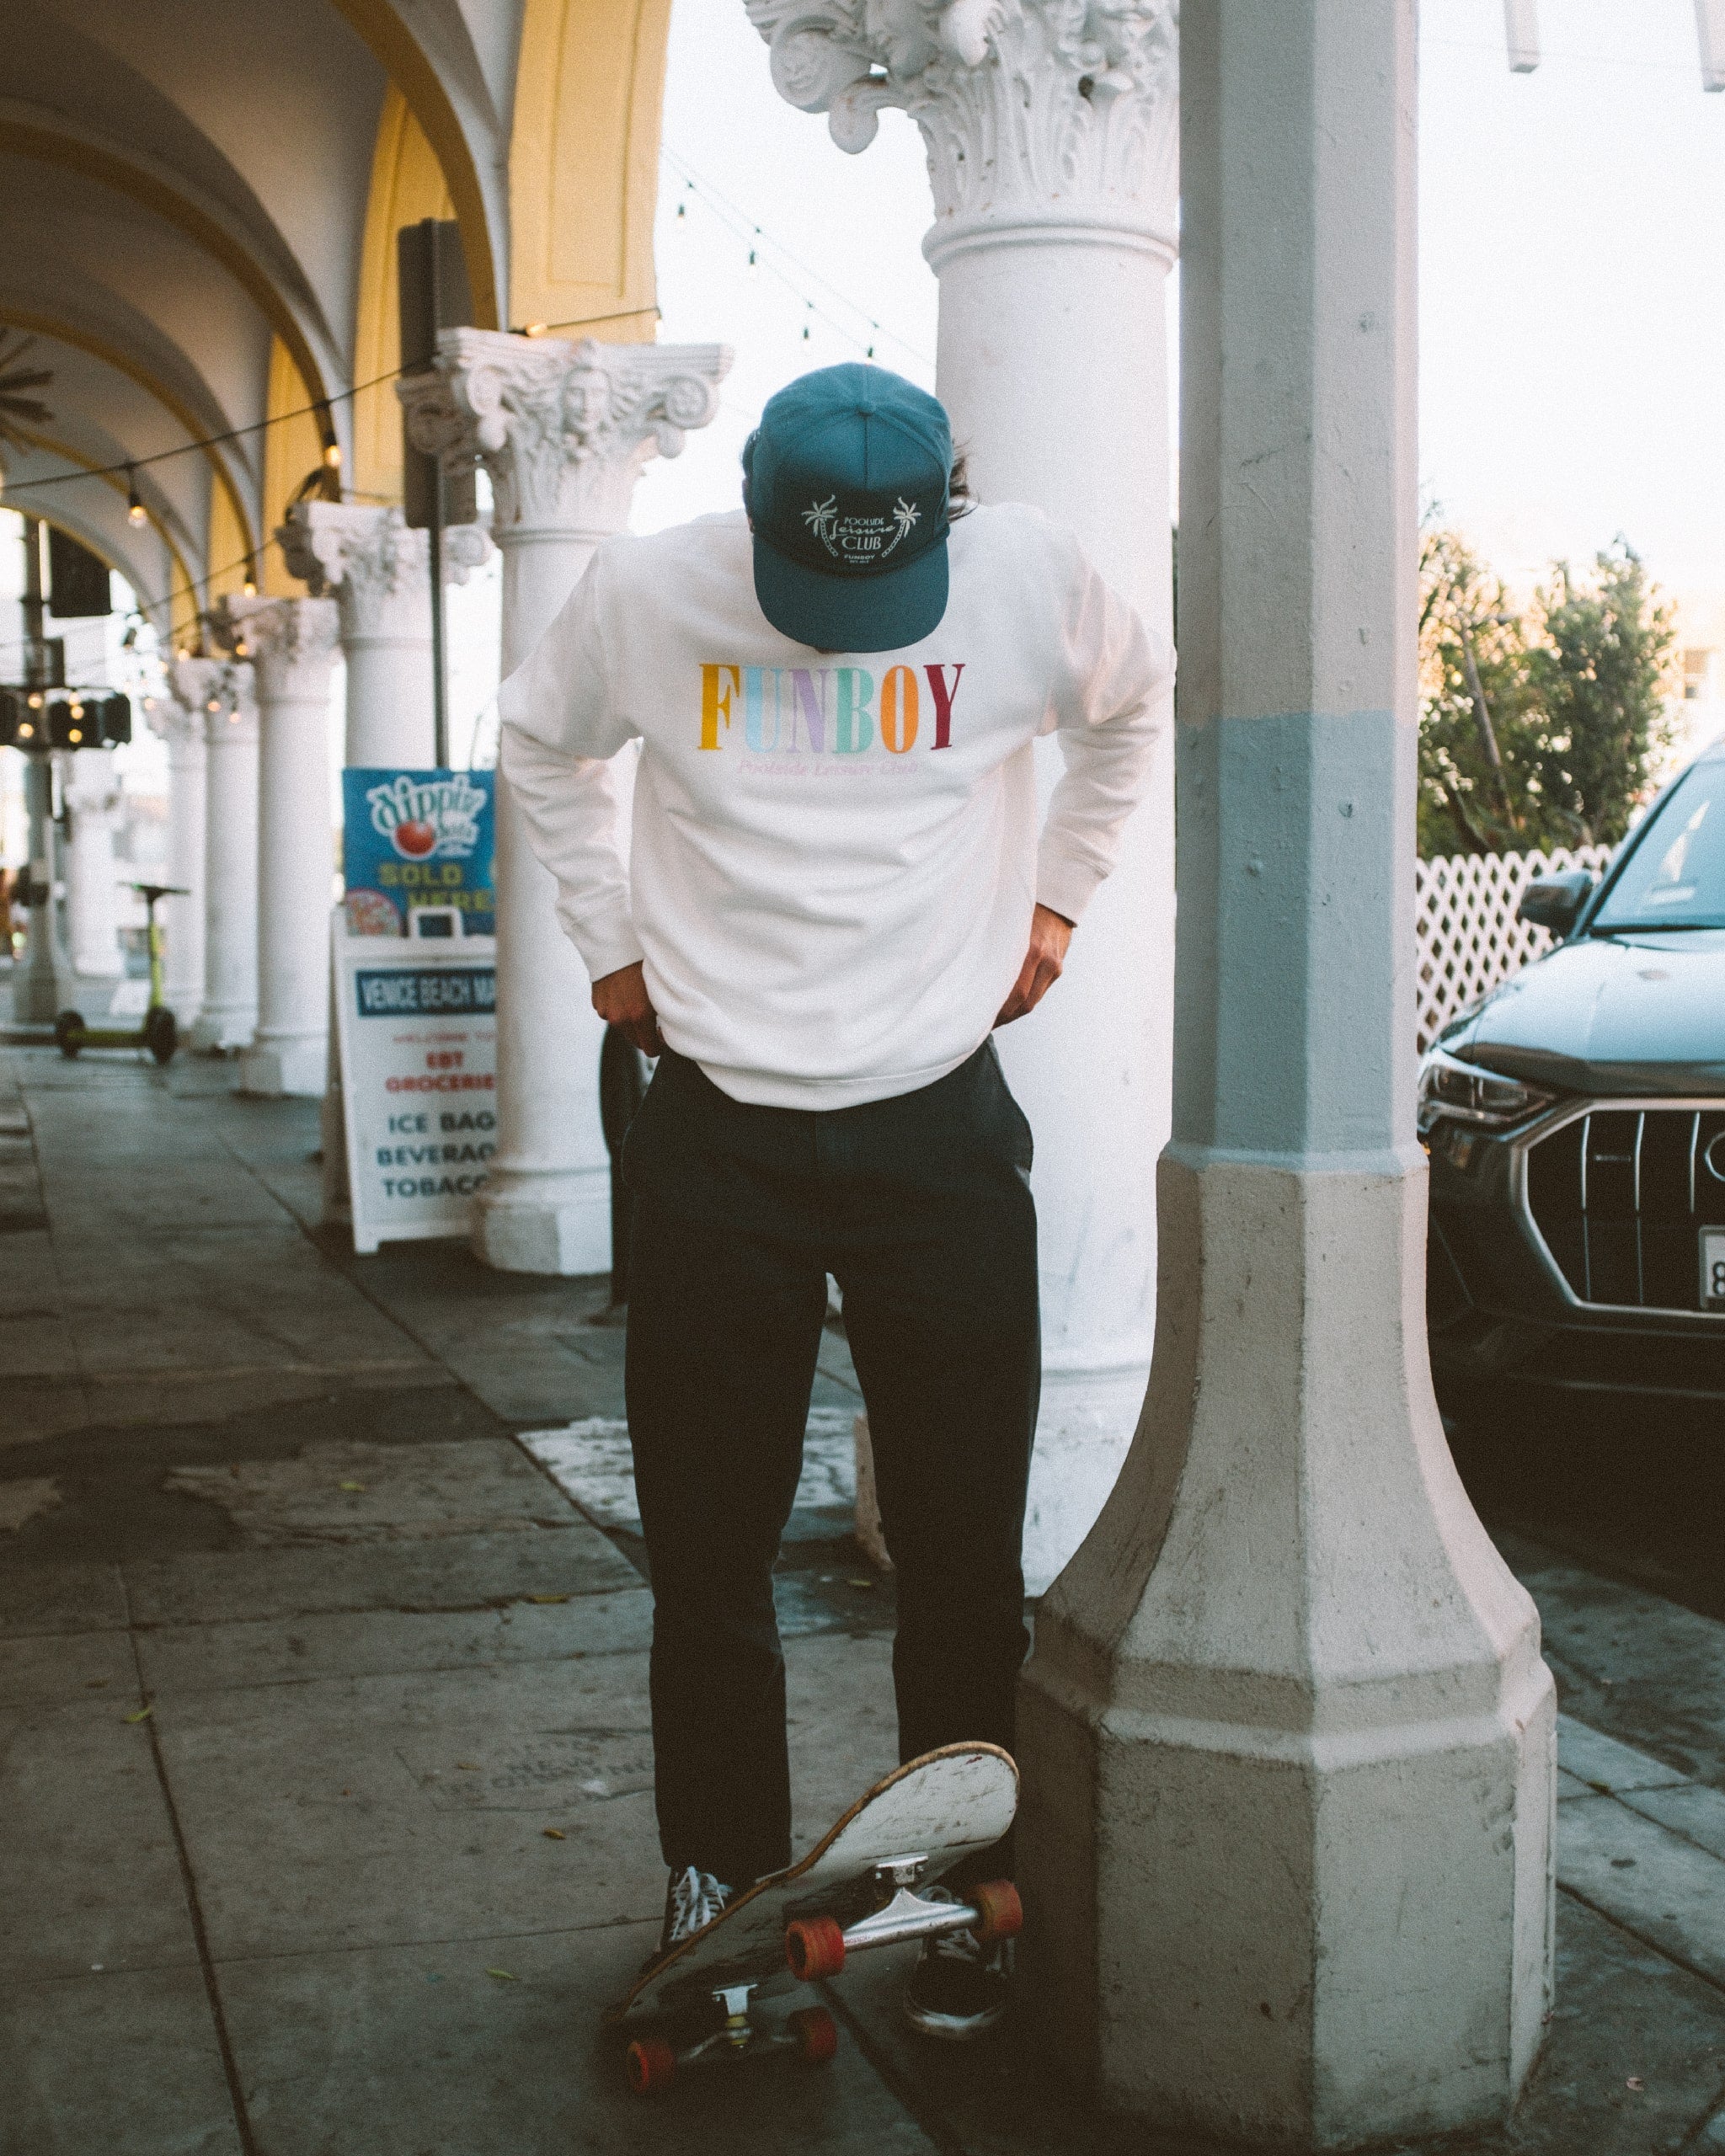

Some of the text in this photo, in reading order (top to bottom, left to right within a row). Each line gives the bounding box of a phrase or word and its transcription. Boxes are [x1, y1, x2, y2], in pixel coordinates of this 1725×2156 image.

[829, 519, 896, 541] Leisure
[844, 516, 884, 526] POOLSIDE
[841, 536, 882, 551] CLUB
[697, 663, 966, 754] FUNBOY
[379, 862, 463, 887] SOLD
[408, 890, 492, 914] HERE
[388, 1114, 428, 1134] ICE
